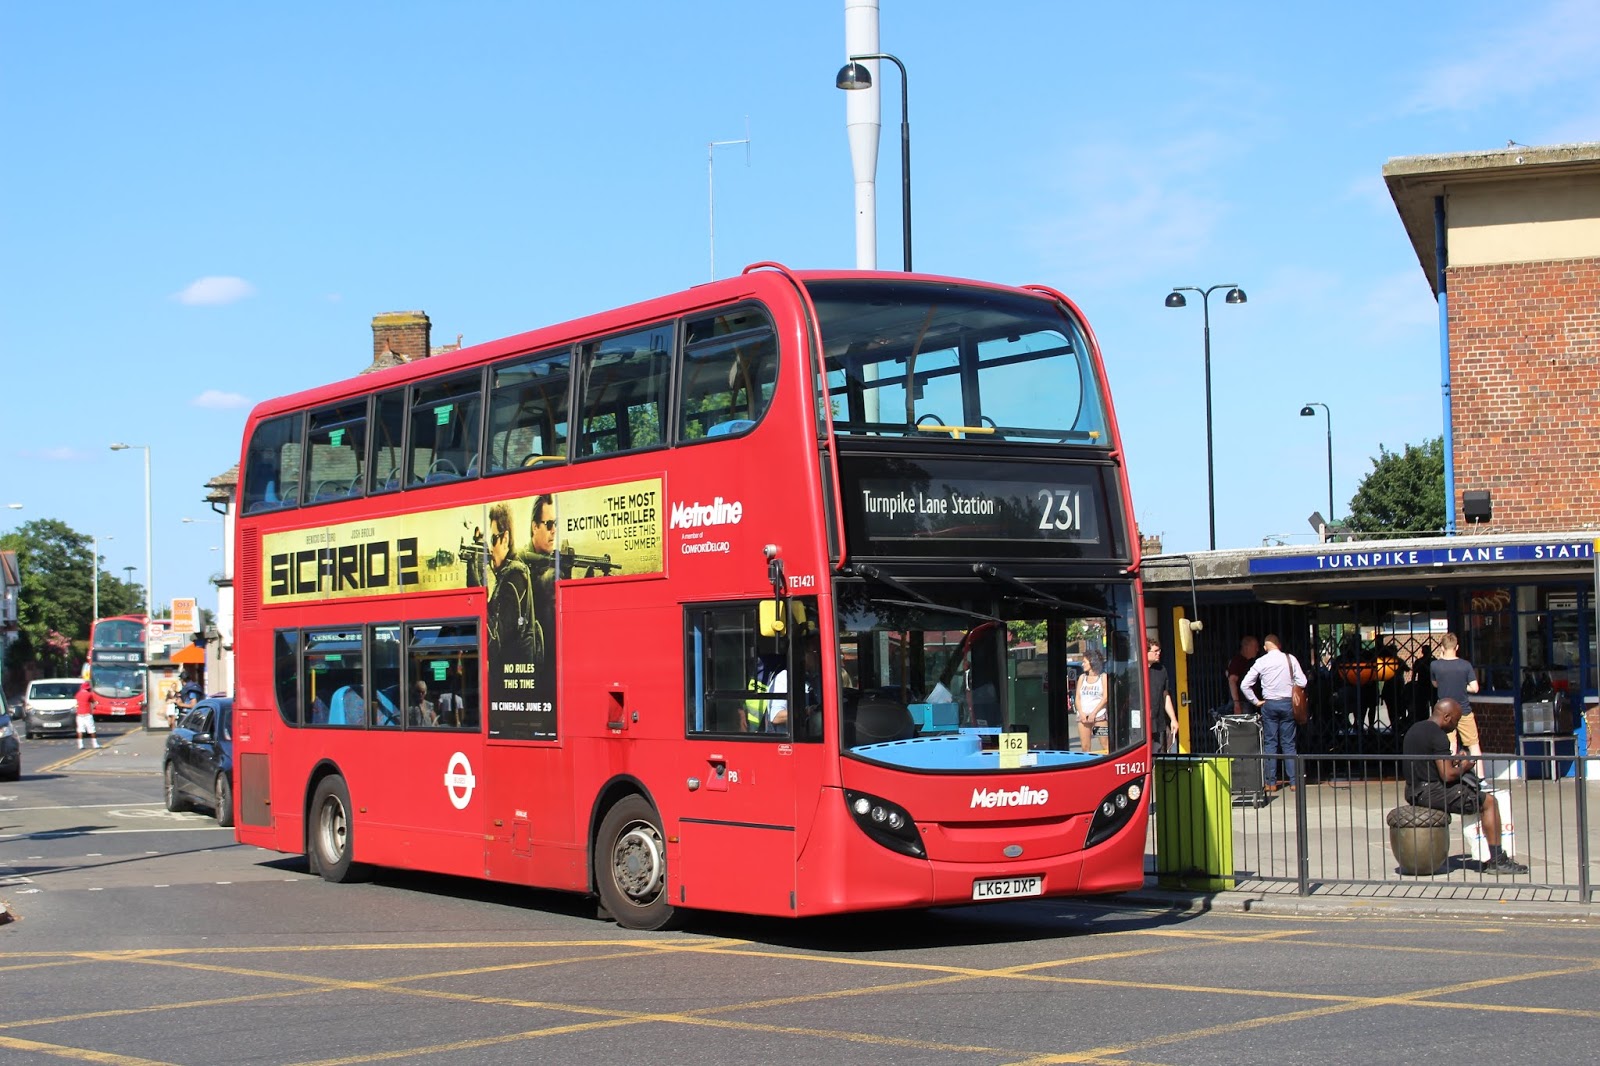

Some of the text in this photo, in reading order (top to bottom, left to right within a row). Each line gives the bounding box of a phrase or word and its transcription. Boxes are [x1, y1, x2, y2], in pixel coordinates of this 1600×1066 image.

[629, 492, 656, 508] MOST
[863, 490, 994, 519] Turnpike Lane Station
[670, 497, 743, 529] Metroline
[1038, 489, 1081, 530] 231
[567, 508, 656, 532] EXCITING THRILLER
[596, 524, 656, 541] YOU'LL SEE THIS
[1317, 544, 1594, 568] TURNPIKE LANE STATI
[271, 537, 419, 597] SICARIO 2
[788, 574, 815, 588] TE1421
[504, 663, 535, 673] NO RULES
[504, 679, 535, 689] THIS TIME
[491, 701, 552, 712] IN CINEMAS JUNE 29
[1004, 738, 1023, 749] 162
[728, 770, 738, 782] PB
[1115, 762, 1146, 775] TE1421
[970, 785, 1049, 808] Metroline
[978, 879, 1036, 896] LK62 DXP
